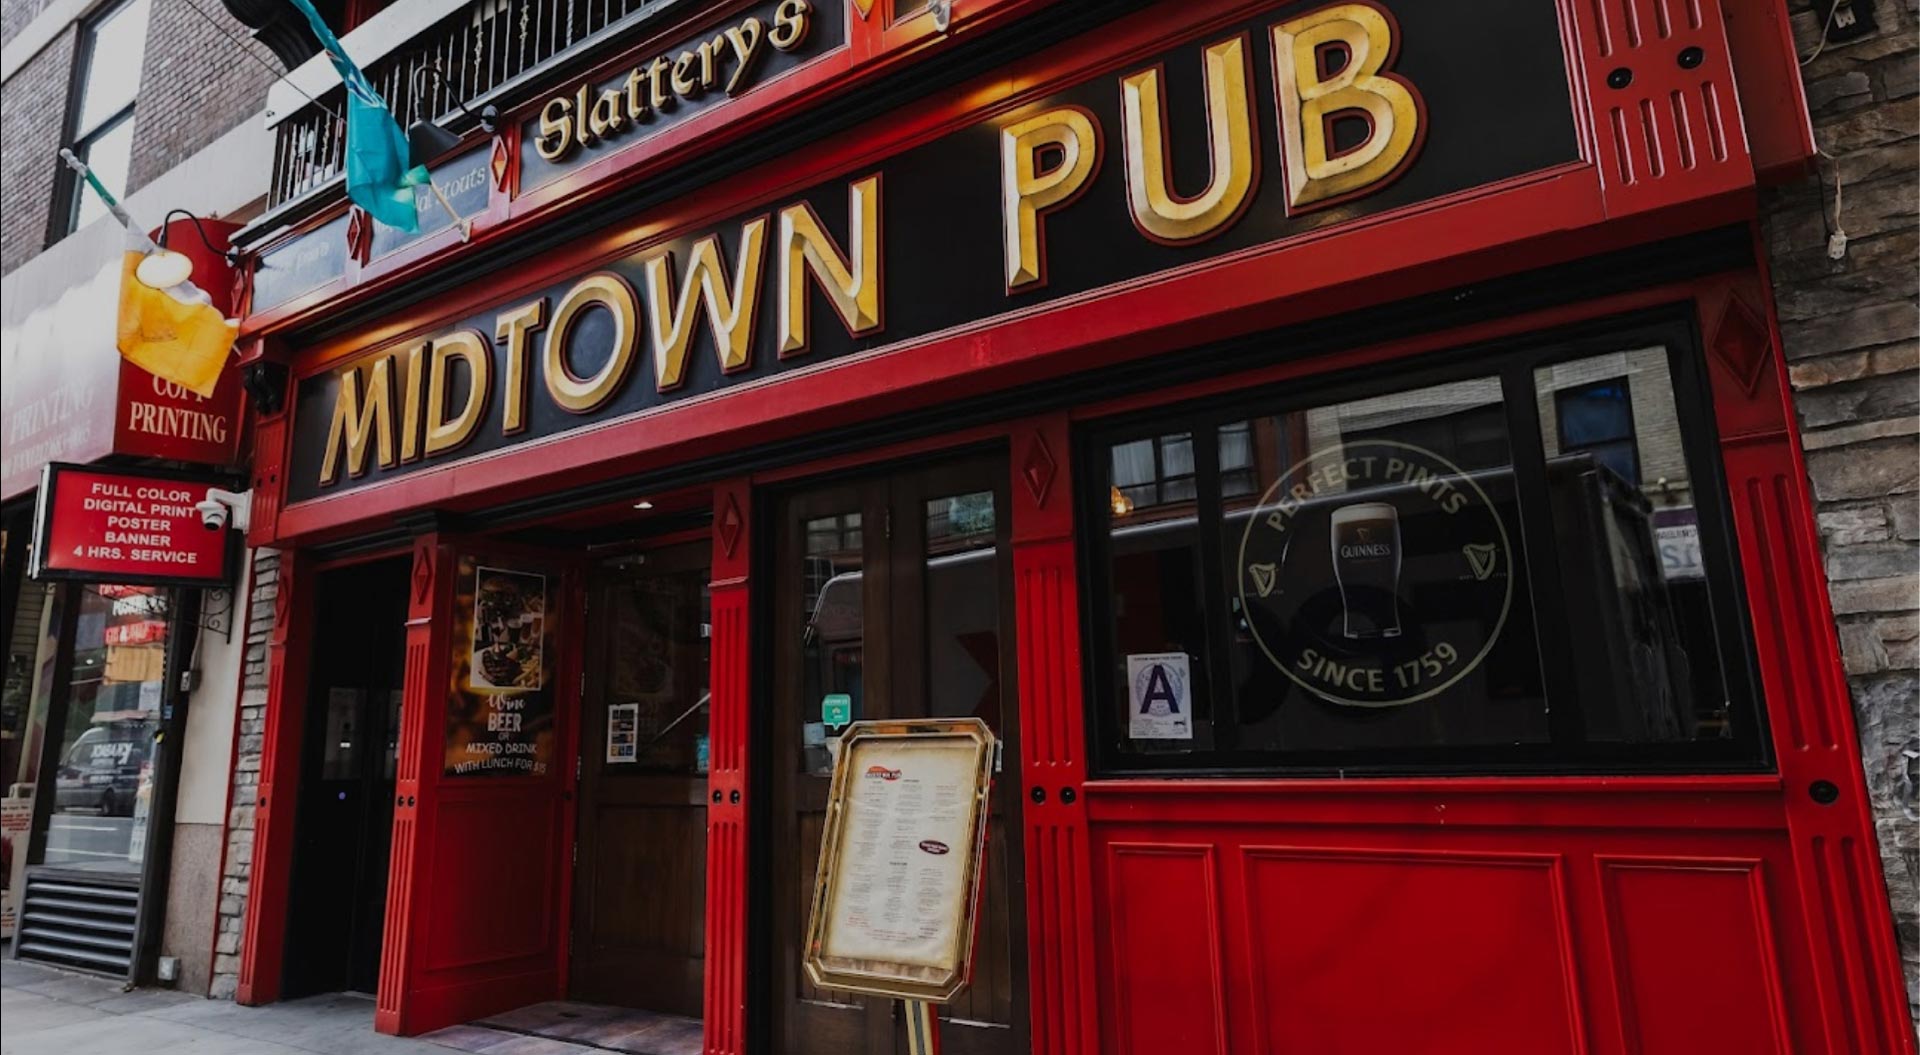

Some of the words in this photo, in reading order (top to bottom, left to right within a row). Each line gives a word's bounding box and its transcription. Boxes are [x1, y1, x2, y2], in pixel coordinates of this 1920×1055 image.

[436, 167, 486, 204] touts
[319, 171, 884, 487] MIDTOWN
[1001, 0, 1428, 296] PUB
[129, 401, 227, 443] PRINTING
[91, 482, 132, 498] FULL
[136, 487, 191, 502] COLOR
[1266, 456, 1377, 532] PERFECT
[1385, 457, 1468, 514] PINTS
[84, 498, 146, 514] DIGITAL
[150, 503, 196, 518] PRINT
[108, 516, 171, 531] POSTER
[105, 531, 171, 547] BANNER
[73, 546, 83, 557] 4
[88, 547, 125, 560] HRS.
[130, 549, 197, 564] SERVICE
[1341, 543, 1391, 559] GUINNESS
[1297, 648, 1385, 692] SINCE
[1393, 642, 1458, 689] 1759
[1139, 664, 1181, 714] A
[487, 713, 522, 732] BEER
[465, 742, 503, 754] MIXED
[505, 743, 538, 754] DRINK
[454, 759, 480, 774] WITH
[481, 758, 513, 769] LUNCH
